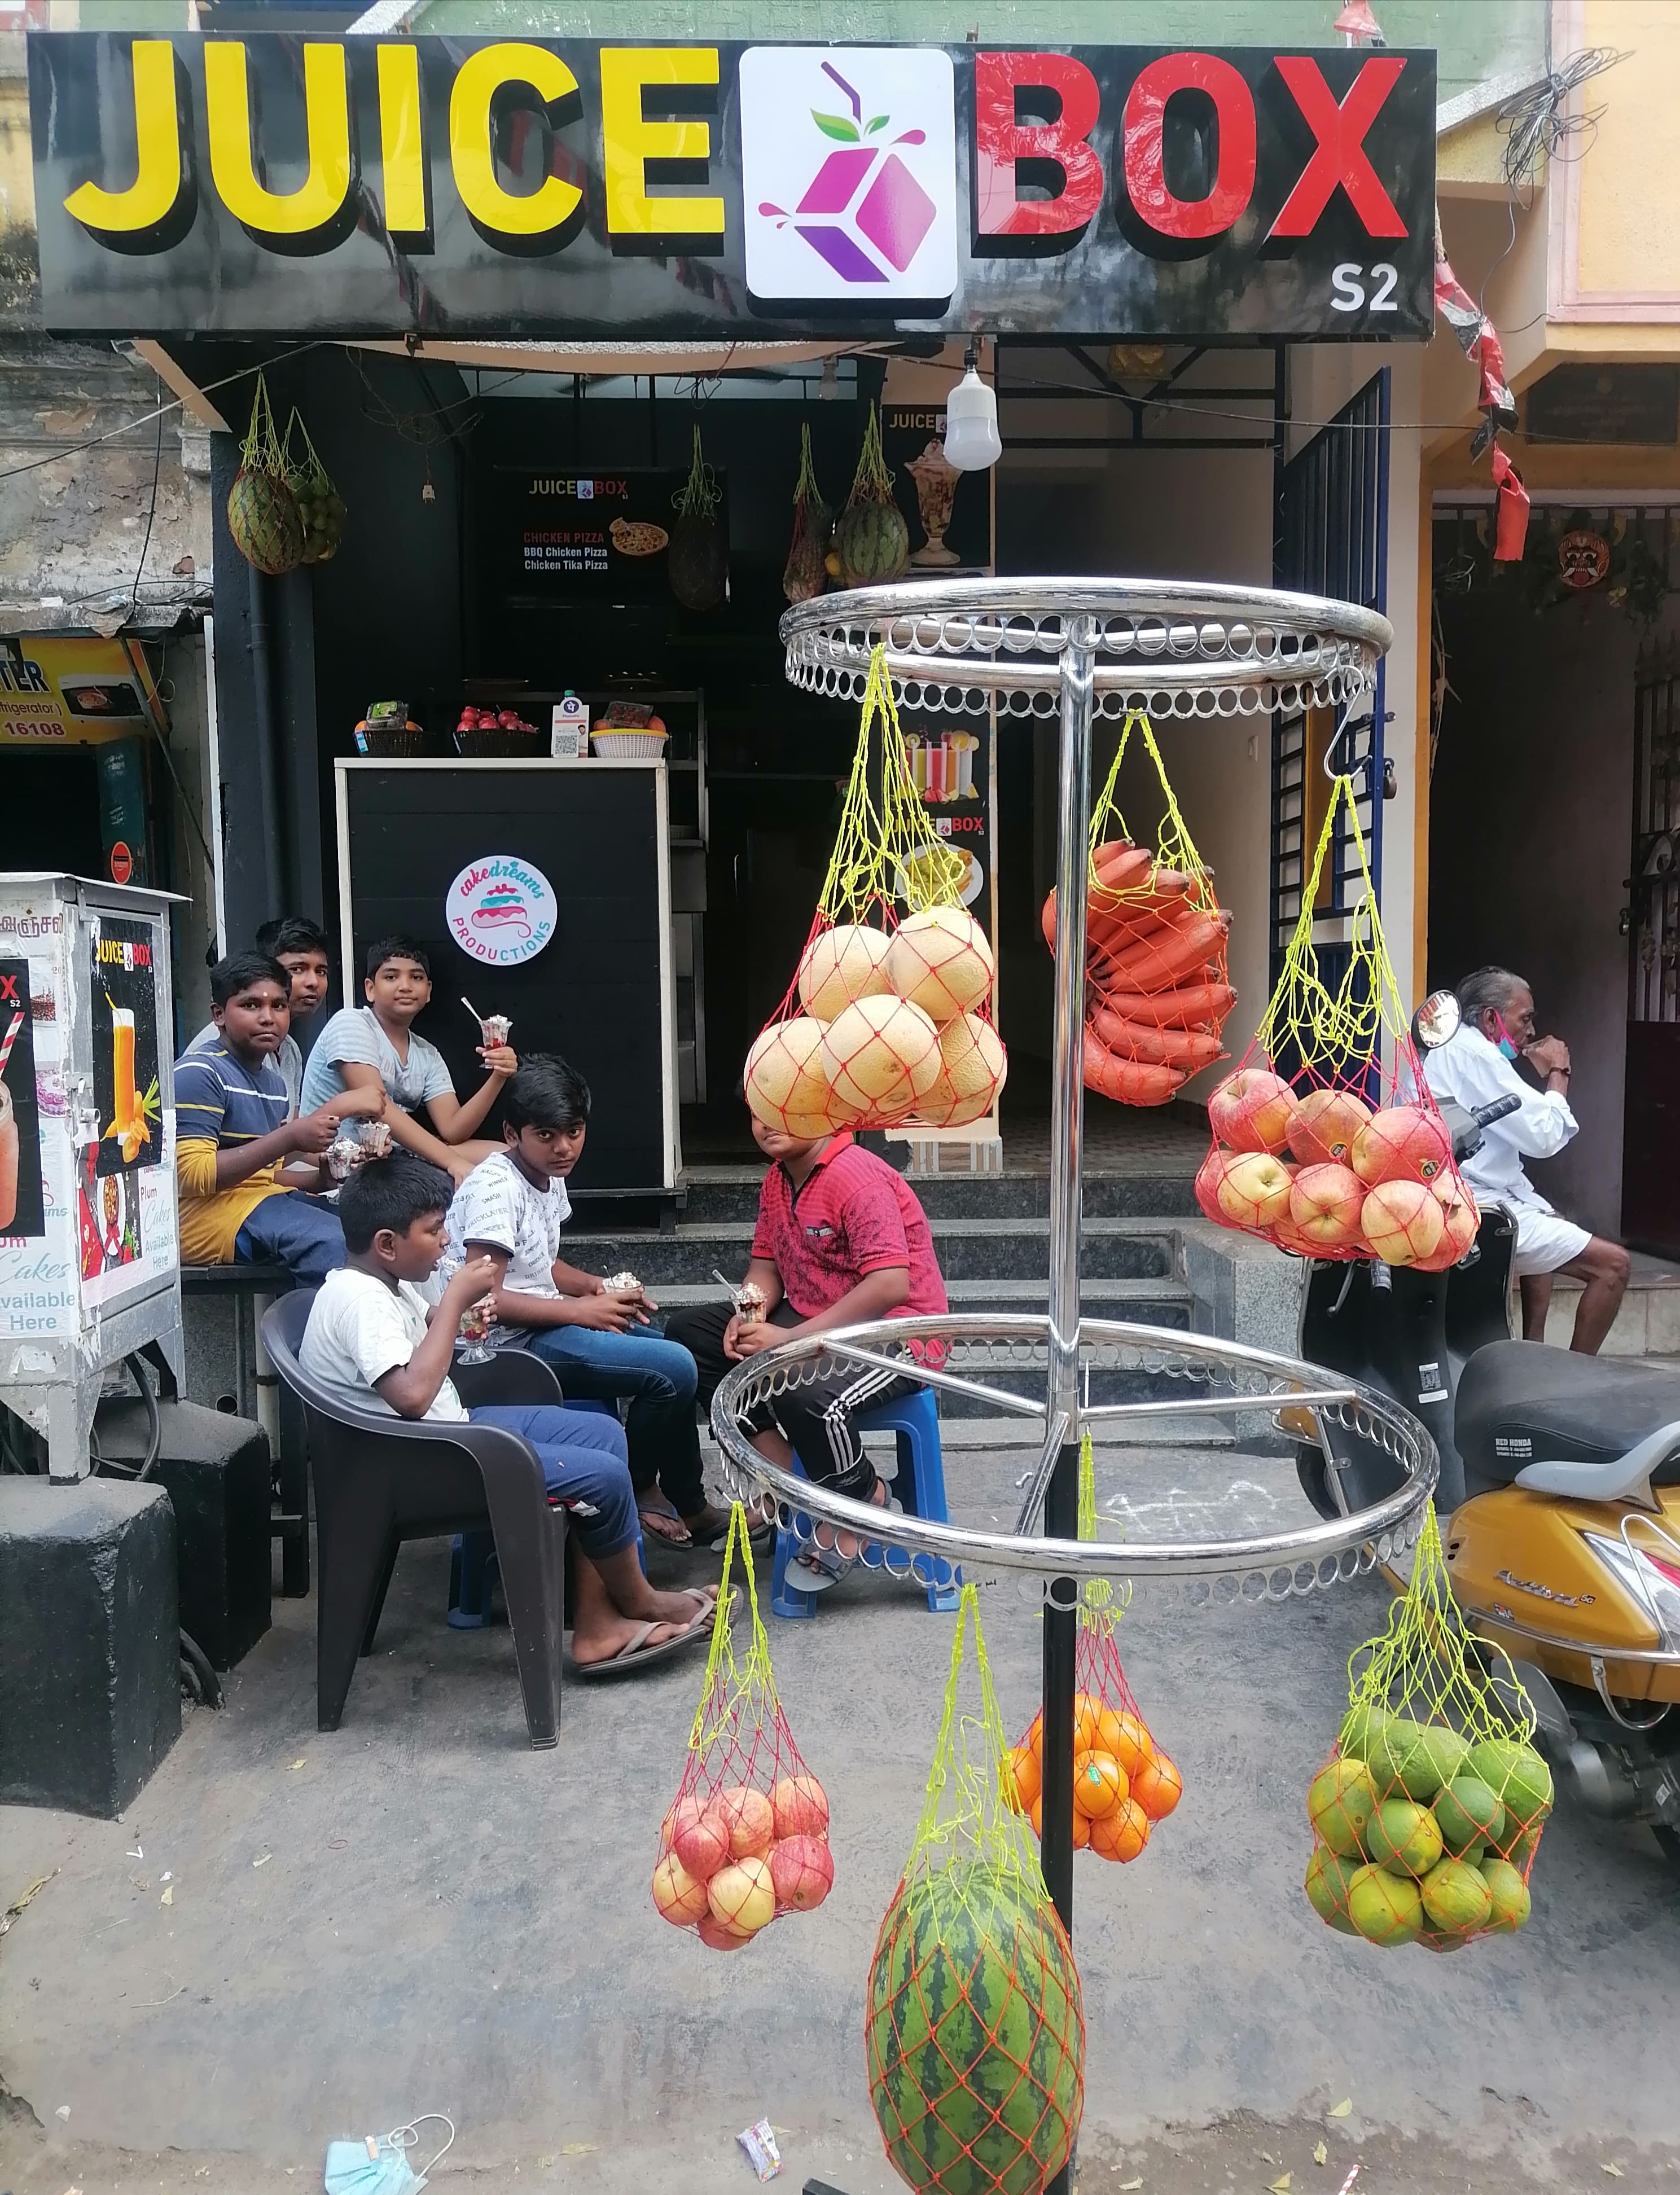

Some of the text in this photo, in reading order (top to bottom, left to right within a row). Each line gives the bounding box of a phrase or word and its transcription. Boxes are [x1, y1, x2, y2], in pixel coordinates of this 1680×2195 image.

[63, 40, 1409, 239] JUICE BOX
[1330, 263, 1398, 311] S2
[889, 414, 935, 428] JUICE
[529, 480, 627, 495] JUICE BOX
[524, 532, 604, 543] CHICKEN PIZZA
[524, 547, 608, 557] BBQ Chicken Pizza
[524, 560, 608, 570] Chicken Tika Pizza
[0, 660, 50, 692] TER
[0, 701, 54, 715] frigerator
[5, 722, 65, 736] 16108
[893, 817, 984, 833] JUCE BOX
[460, 860, 545, 899] cakedreams
[453, 917, 551, 961] PRODUCTIONS
[95, 940, 152, 966] JUICE BOX
[10, 999, 21, 1008] S2
[141, 1187, 157, 1201] Plum
[481, 1192, 502, 1205] SMASH
[144, 1200, 171, 1233] Cakes
[145, 1232, 174, 1254] Available
[0, 1250, 71, 1283] Cakes
[152, 1254, 169, 1270] Here
[0, 1292, 75, 1309] vailable
[10, 1314, 57, 1331] Here
[1509, 1438, 1532, 1447] HONDA
